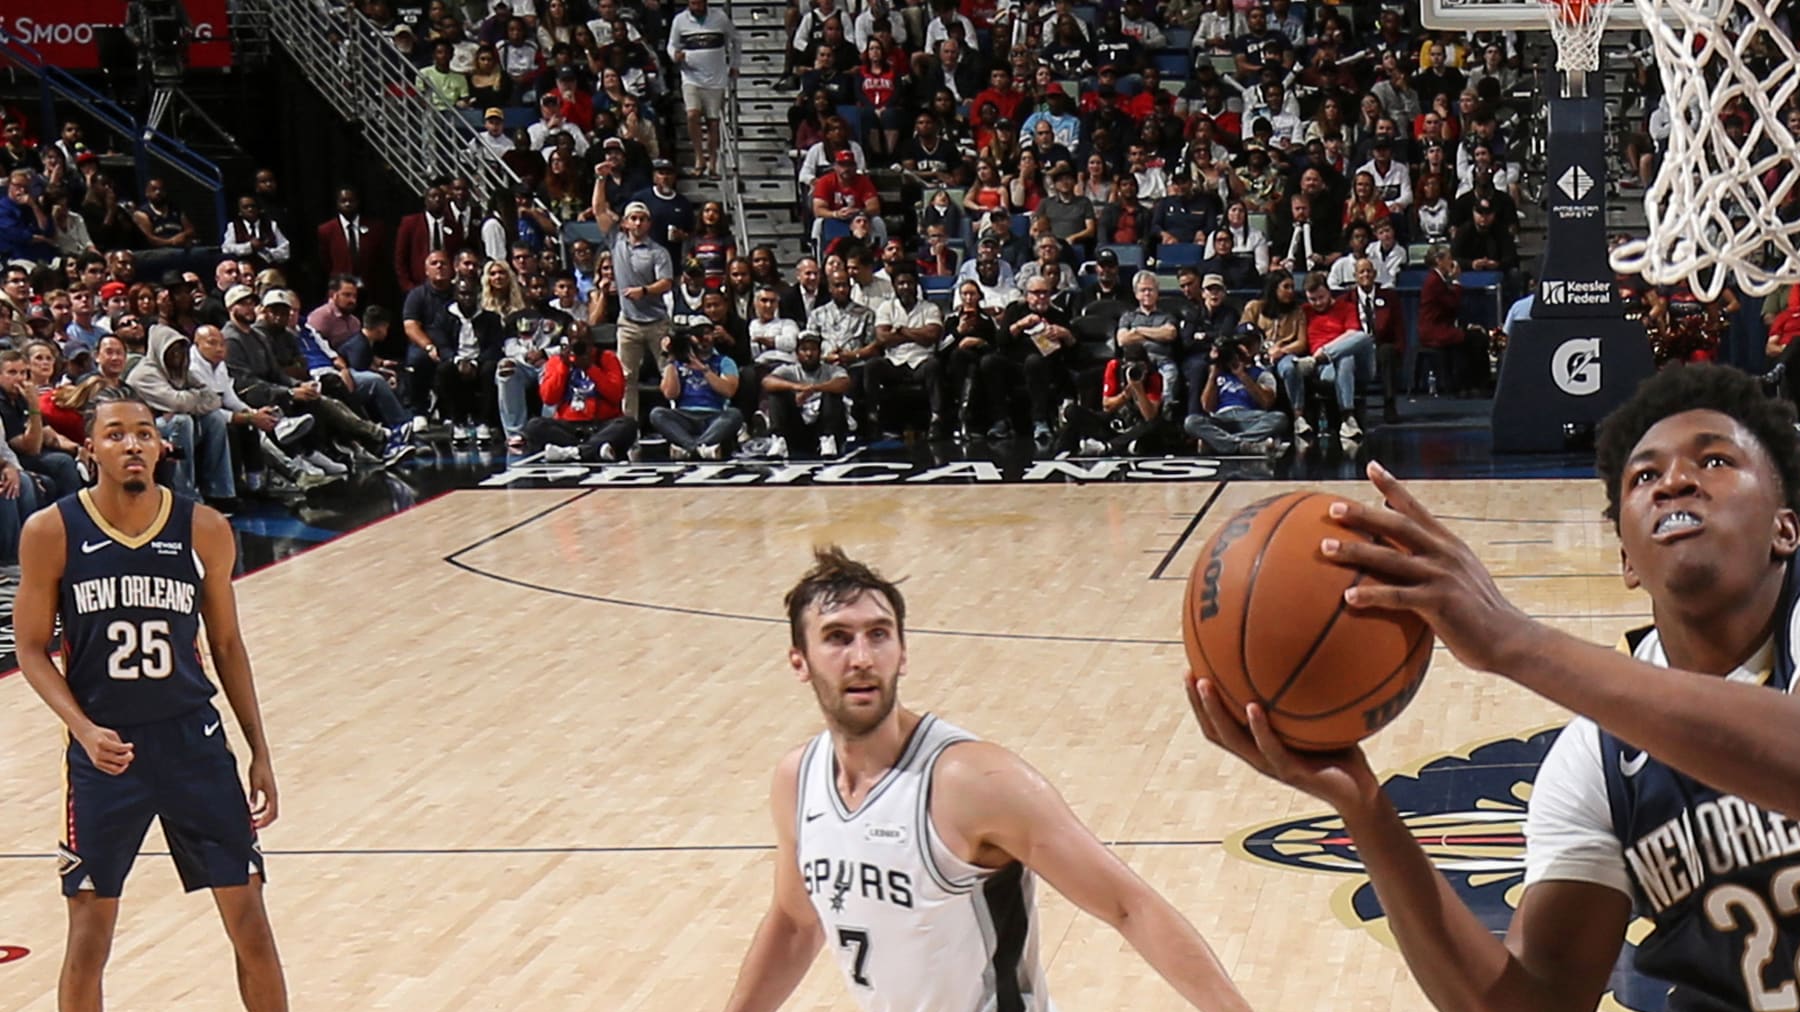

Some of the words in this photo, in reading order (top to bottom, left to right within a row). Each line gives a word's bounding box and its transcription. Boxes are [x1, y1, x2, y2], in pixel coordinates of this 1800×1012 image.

[1567, 280, 1611, 292] Keesler
[1567, 292, 1611, 304] Federal
[1551, 338, 1602, 395] G
[477, 461, 1222, 486] PELICANS
[72, 577, 117, 615] NEW
[120, 575, 195, 615] ORLEANS
[106, 620, 174, 680] 25
[803, 858, 915, 914] SPURS
[837, 926, 873, 989] 7
